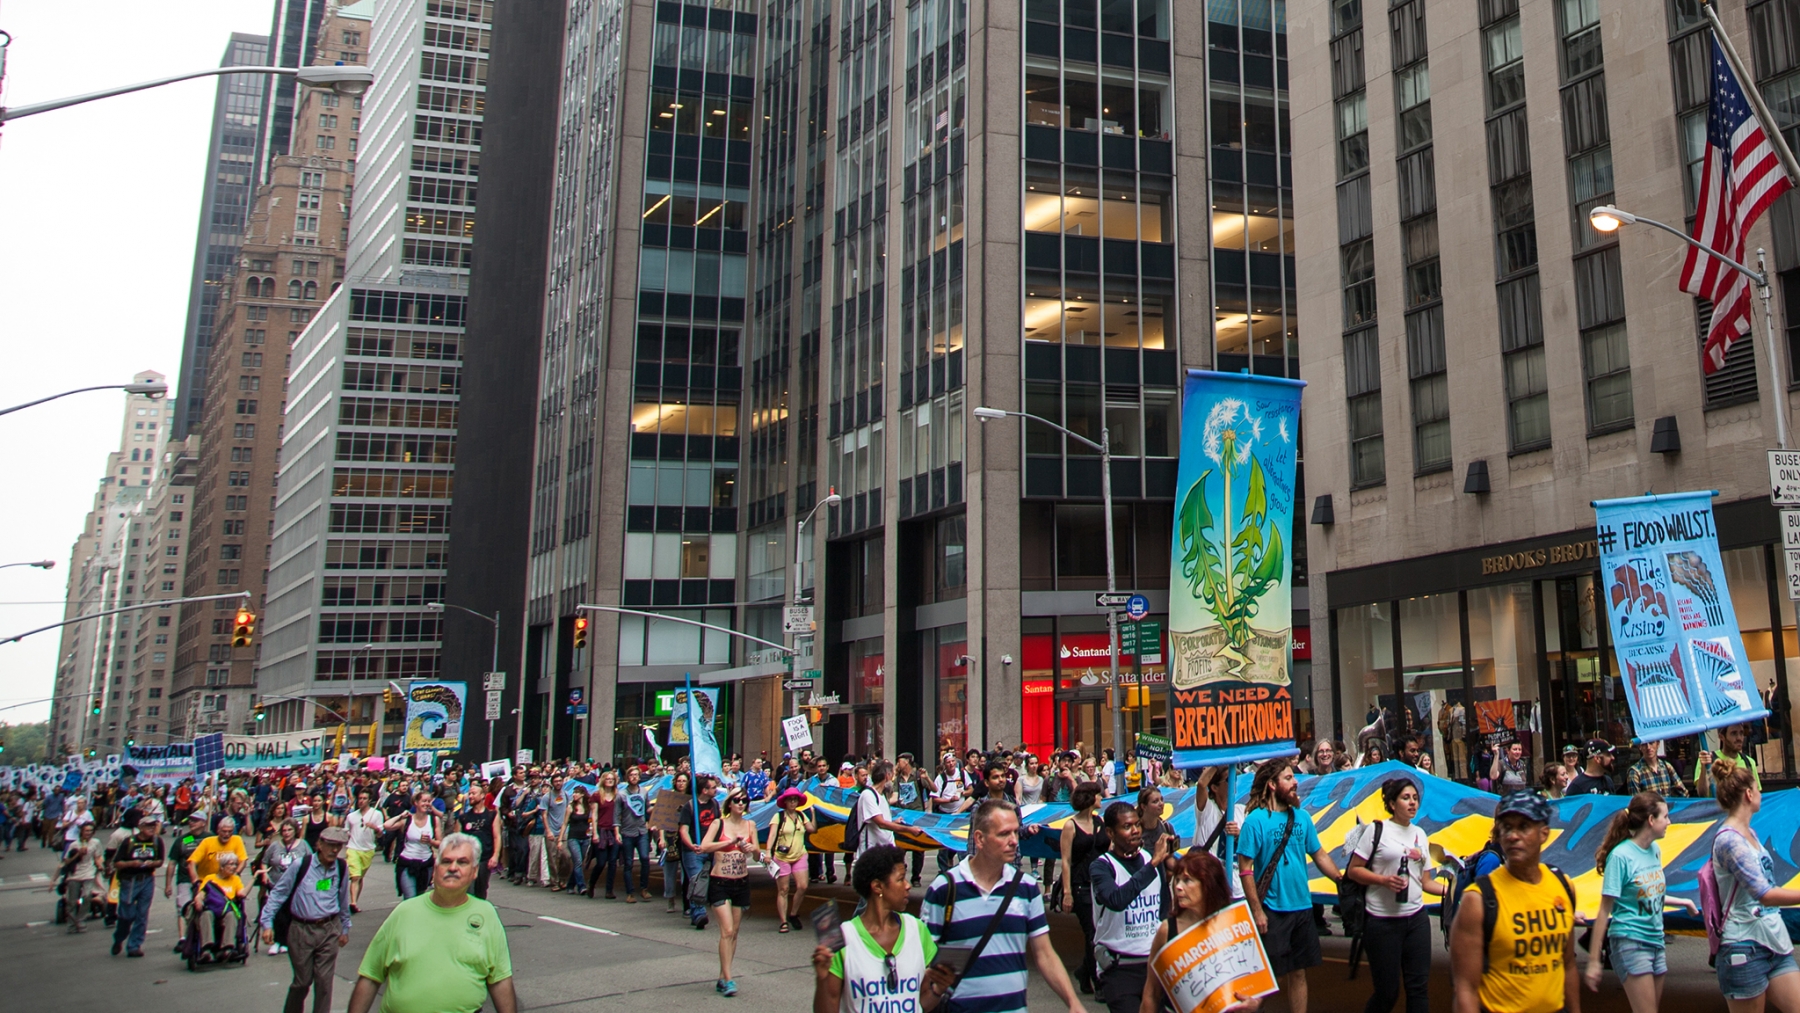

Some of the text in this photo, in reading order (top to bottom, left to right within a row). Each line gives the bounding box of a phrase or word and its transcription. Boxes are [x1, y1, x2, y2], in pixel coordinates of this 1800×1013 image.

[1256, 400, 1271, 412] Sow
[1276, 449, 1287, 465] Let
[1788, 514, 1800, 527] BU
[1787, 531, 1800, 545] LA
[1481, 539, 1600, 575] BROOKS BROT
[1628, 557, 1662, 581] Tide
[1620, 616, 1665, 638] Rising
[1072, 645, 1121, 657] Santandr
[1024, 685, 1054, 694] Santan
[1174, 687, 1292, 704] WE NEED A
[1174, 700, 1294, 748] BREAKTHROUGH
[790, 731, 809, 741] RIGHT
[1142, 735, 1171, 746] WINDMILL
[130, 744, 195, 759] CAPITALI
[256, 740, 293, 760] WALL
[300, 737, 321, 757] ST
[1139, 749, 1167, 760] WEAPON
[166, 758, 182, 766] THE
[1634, 869, 1663, 886] CLIMAT
[1637, 882, 1666, 899] ACTIO
[1126, 894, 1160, 909] atura
[1512, 908, 1567, 935] SHUT
[1125, 930, 1149, 938] Walking
[1162, 920, 1253, 986] I'M MARCHING FOR
[1508, 959, 1548, 976] Indian
